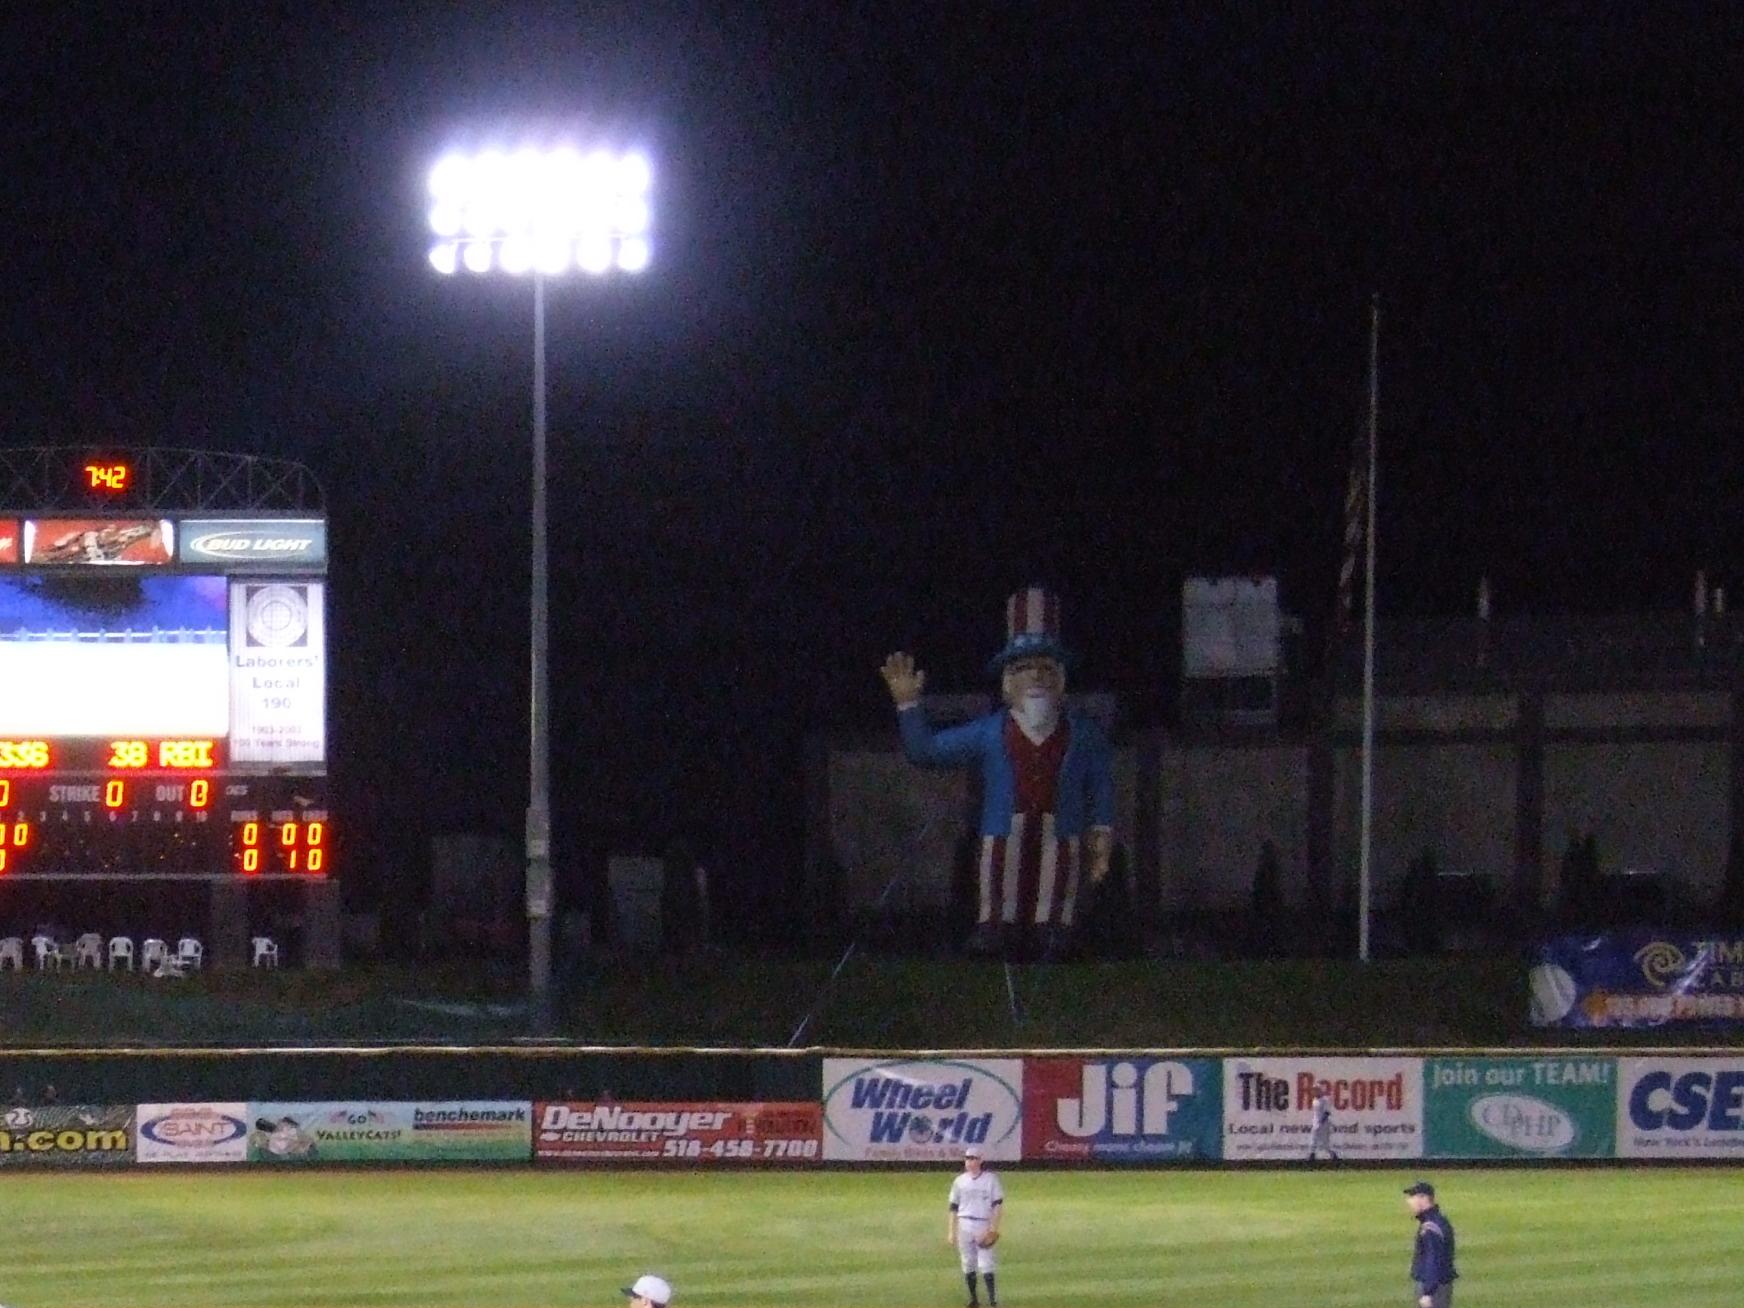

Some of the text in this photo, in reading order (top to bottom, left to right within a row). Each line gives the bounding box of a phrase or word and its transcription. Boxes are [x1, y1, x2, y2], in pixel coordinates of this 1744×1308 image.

[206, 538, 313, 551] BUD LIGHT
[236, 655, 319, 668] Laborers'
[252, 676, 301, 689] Local
[263, 697, 292, 709] 190
[159, 741, 213, 767] RBI
[49, 785, 101, 801] STRIKE
[105, 780, 124, 807] 0
[156, 785, 184, 801] OUT
[13, 823, 28, 845] 0
[243, 823, 258, 845] 0
[282, 823, 296, 845] 0
[307, 823, 322, 845] 0
[243, 849, 258, 871] 0
[307, 849, 322, 871] 0
[1434, 1061, 1609, 1088] Join our TEAM!
[851, 1077, 973, 1110] Wheel
[1057, 1061, 1194, 1137] Jif
[1238, 1071, 1290, 1112] The
[1629, 1071, 1744, 1131] CSE
[347, 1113, 367, 1125] GO
[412, 1107, 526, 1123] benchemark
[541, 1106, 732, 1136] DeNooyer
[562, 1131, 660, 1142] CHEVROLET
[869, 1111, 993, 1145] World
[1229, 1122, 1274, 1135] Local
[1279, 1124, 1314, 1135] new
[1365, 1122, 1416, 1137] sports
[663, 1139, 818, 1158] 518-458-7700
